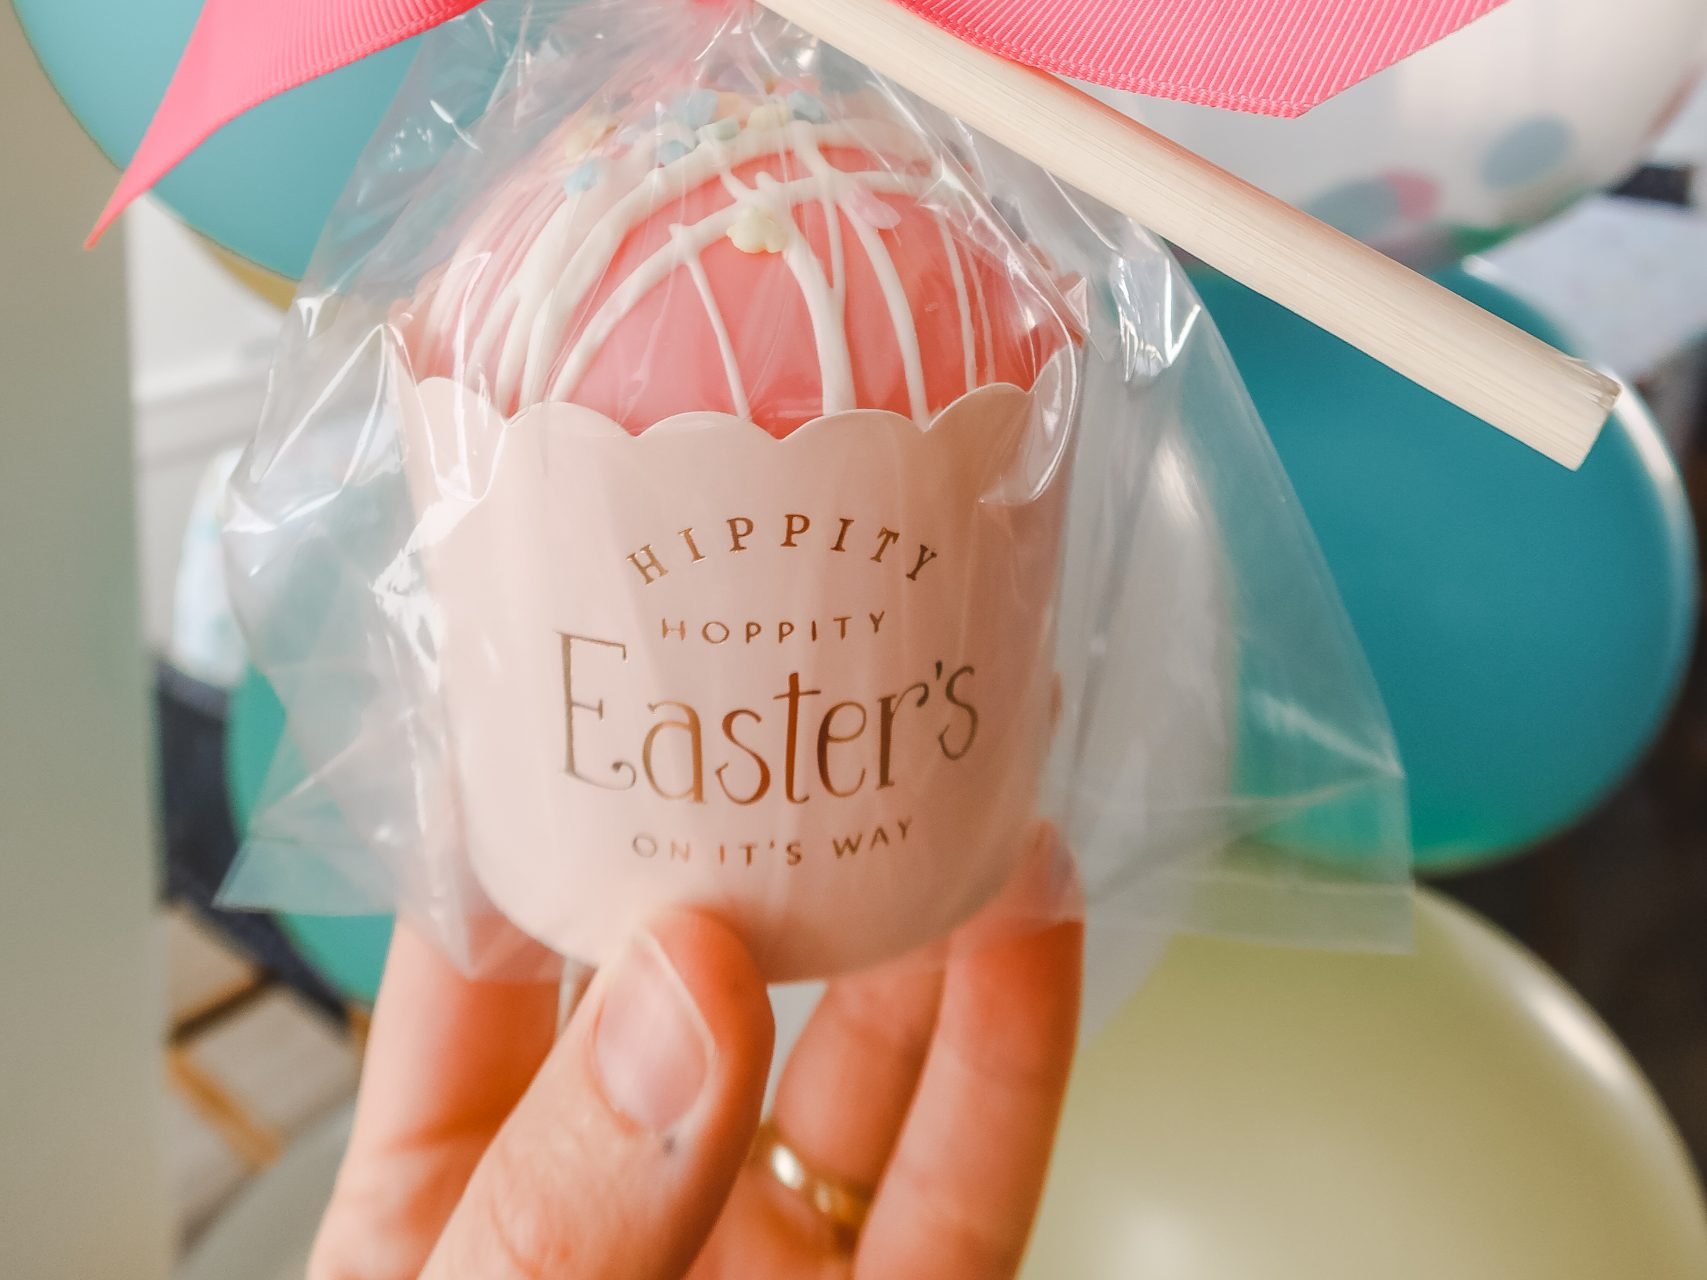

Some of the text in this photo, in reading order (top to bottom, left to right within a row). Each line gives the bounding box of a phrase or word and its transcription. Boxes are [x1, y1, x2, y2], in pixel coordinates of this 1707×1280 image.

[626, 514, 938, 585] HIPPITY
[661, 611, 886, 645] HOPPITY
[554, 629, 980, 806] Easter's
[632, 819, 913, 867] ON IT'S WAY
